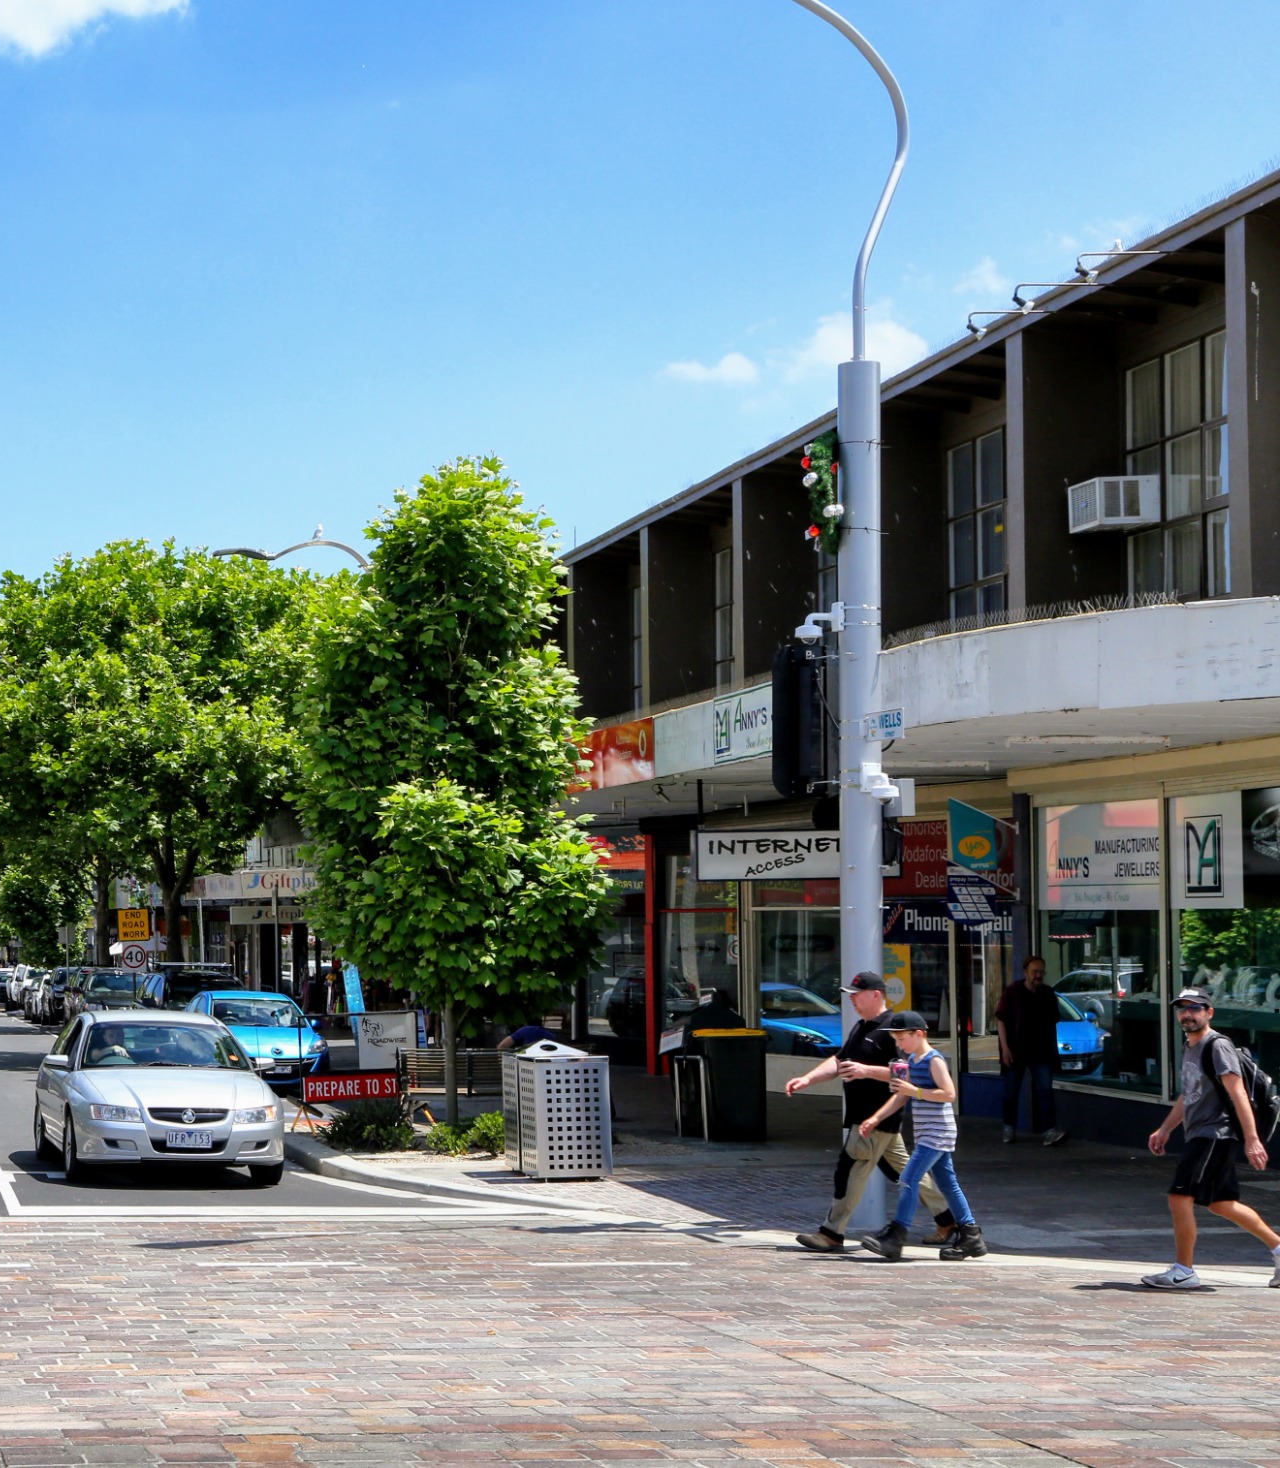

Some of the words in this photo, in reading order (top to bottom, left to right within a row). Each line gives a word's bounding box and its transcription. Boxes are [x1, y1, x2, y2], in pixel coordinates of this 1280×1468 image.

[879, 711, 902, 729] WELLS
[1094, 836, 1159, 855] MANUFACTURING
[744, 853, 805, 877] ACCESS
[1114, 860, 1159, 878] JEWELLERS
[261, 872, 316, 893] Giftplu
[904, 909, 950, 931] Phone
[122, 930, 146, 938] WORK
[125, 951, 144, 963] 40
[308, 1080, 361, 1098] PREPARE
[366, 1079, 380, 1095] TO
[384, 1078, 397, 1094] ST
[168, 1133, 186, 1144] UFR
[194, 1134, 211, 1144] 153
